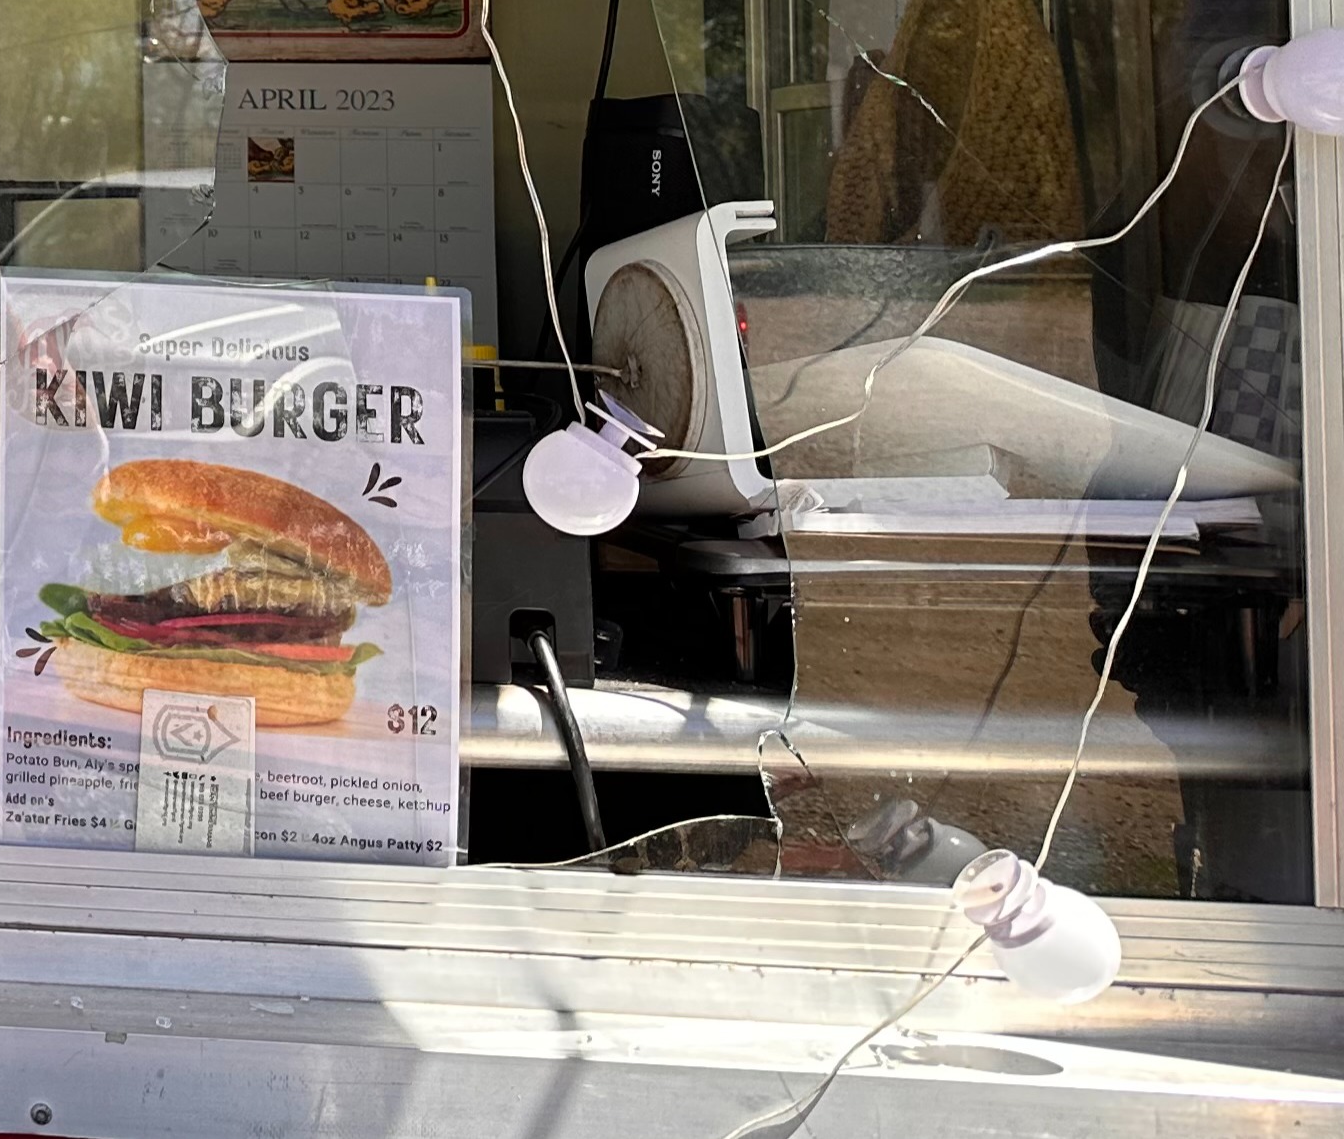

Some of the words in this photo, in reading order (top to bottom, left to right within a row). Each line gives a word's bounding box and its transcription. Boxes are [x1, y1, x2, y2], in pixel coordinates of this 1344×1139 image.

[238, 89, 327, 110] APRIL
[336, 89, 396, 111] 2023
[652, 150, 661, 197] SONY
[252, 185, 259, 194] 4
[345, 187, 352, 196] 6
[391, 187, 397, 197] 7
[438, 188, 445, 198] 8
[207, 228, 218, 238] 10
[253, 229, 262, 239] 11
[299, 231, 310, 241] 12
[346, 232, 356, 241] 13
[392, 233, 403, 242] 14
[439, 233, 450, 243] 15
[138, 333, 204, 361] Super
[212, 336, 309, 362] Delicious
[35, 368, 163, 431] KIWI
[191, 375, 426, 446] BURGER
[387, 703, 438, 736] $12
[7, 726, 113, 750] Ingredients:
[6, 753, 49, 766] Potato
[53, 755, 81, 770] Bun,
[84, 758, 115, 773] Aly's
[267, 770, 327, 787] beetroot,
[330, 776, 379, 790] pickled
[382, 780, 423, 794] onion,
[5, 792, 27, 805] Add
[6, 772, 46, 784] grilled
[49, 775, 116, 791] pineapple,
[260, 788, 290, 802] beef
[293, 791, 340, 806] burger,
[343, 794, 394, 811] cheese,
[398, 799, 451, 814] ketchup
[54, 814, 87, 828] Fries
[90, 817, 107, 829] $4
[280, 829, 298, 843] $2
[311, 833, 337, 846] 4oz
[340, 835, 384, 851] Angus
[387, 838, 423, 854] Patty
[425, 840, 444, 853] $2
